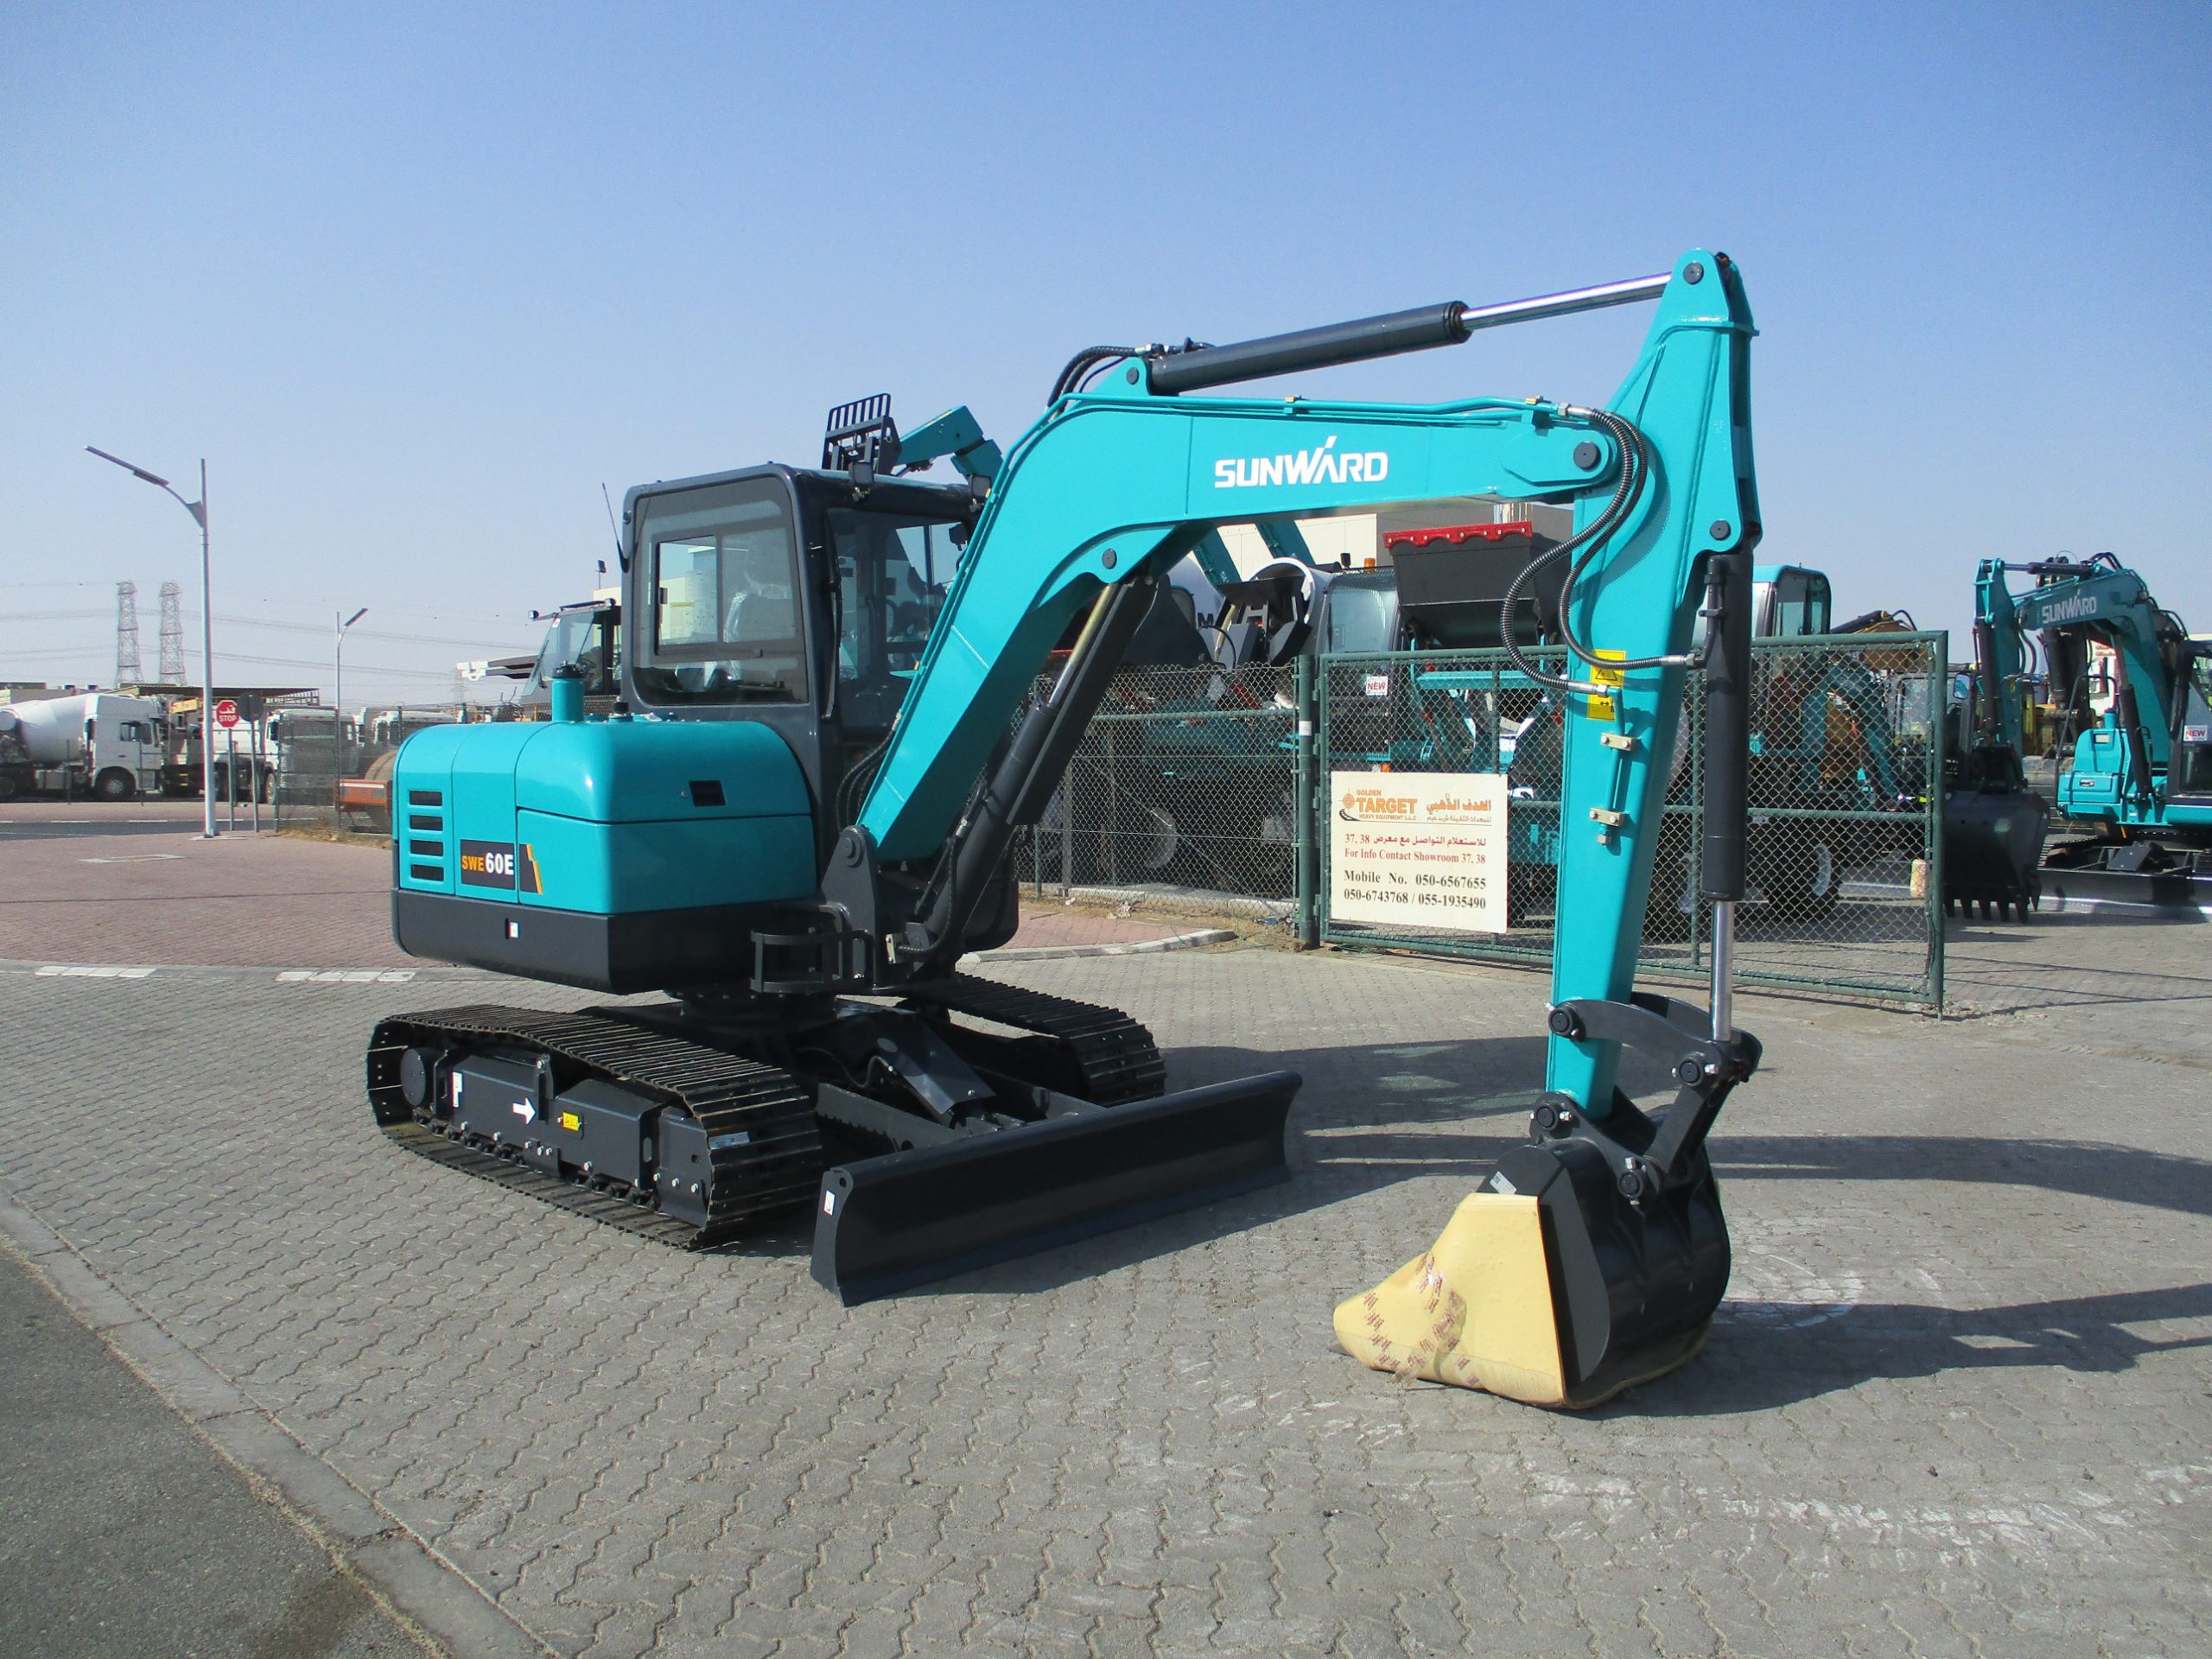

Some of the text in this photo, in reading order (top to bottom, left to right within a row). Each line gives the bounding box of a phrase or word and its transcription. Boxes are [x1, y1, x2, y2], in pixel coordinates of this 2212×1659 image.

[1214, 435, 1389, 488] SUNWARD
[2042, 588, 2097, 624] SUNWARD
[1367, 682, 1386, 690] NEW
[1356, 797, 1418, 814] TARGET
[1462, 798, 1492, 811] الهدف
[1360, 834, 1370, 844] 38
[1373, 835, 1398, 845] معرض
[1400, 836, 1410, 847] مع
[1413, 836, 1445, 846] التواصل
[1447, 836, 1486, 848] للاستعلام
[1344, 848, 1358, 858] For
[1361, 849, 1377, 859] Info
[1379, 850, 1411, 861] Contact
[1414, 851, 1459, 863] Showroom
[1476, 854, 1486, 864] 38
[1344, 870, 1486, 890] Mobile No. 050-6567655
[1344, 888, 1408, 904] 050-6743768
[1418, 893, 1486, 910] 055-1935490
